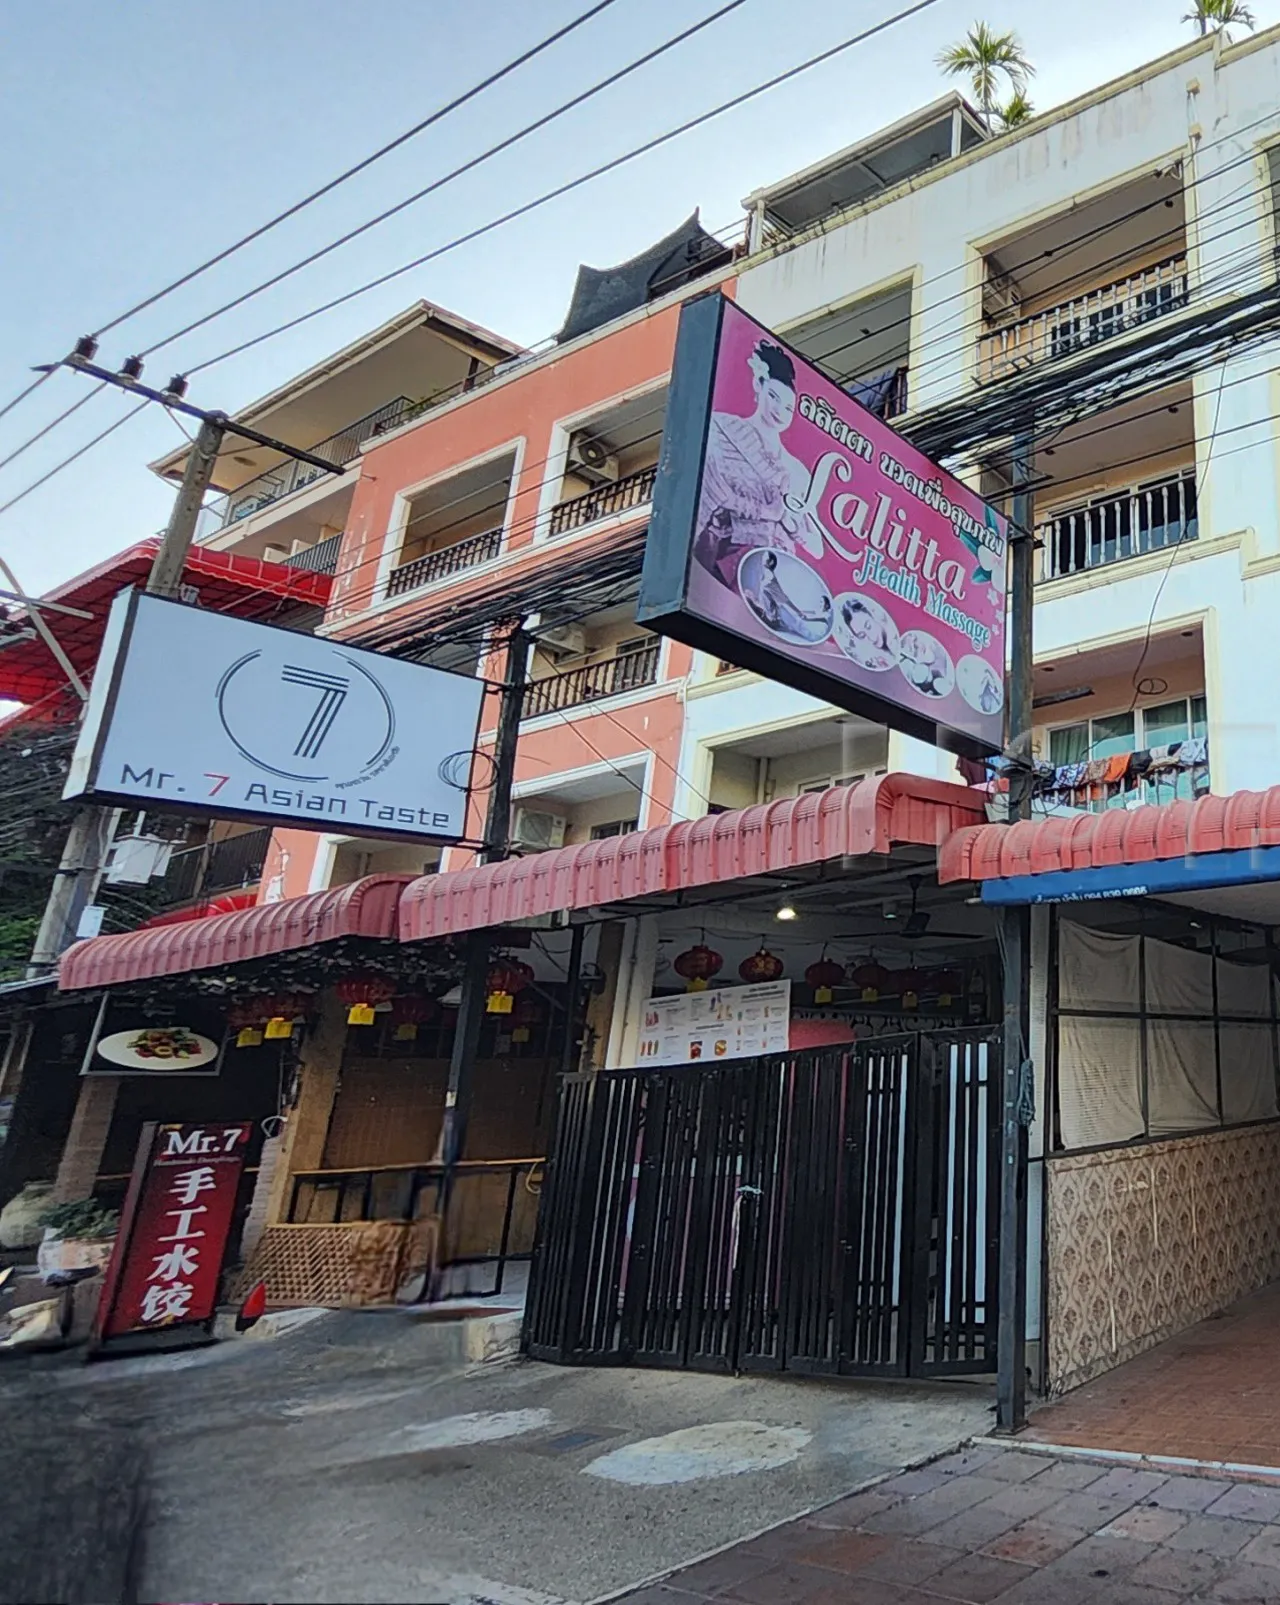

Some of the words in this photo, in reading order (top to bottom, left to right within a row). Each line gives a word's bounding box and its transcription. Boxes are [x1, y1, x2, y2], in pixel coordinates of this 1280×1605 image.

[784, 451, 967, 601] Lalitta
[853, 546, 921, 608] Health
[924, 583, 990, 651] Massage
[281, 664, 350, 759] 7
[120, 763, 186, 793] Mr.
[204, 773, 230, 797] 7
[244, 783, 347, 815] Asian
[359, 798, 450, 829] Taste
[161, 1128, 243, 1155] Mr.7
[140, 1167, 216, 1321] 手工水饺
